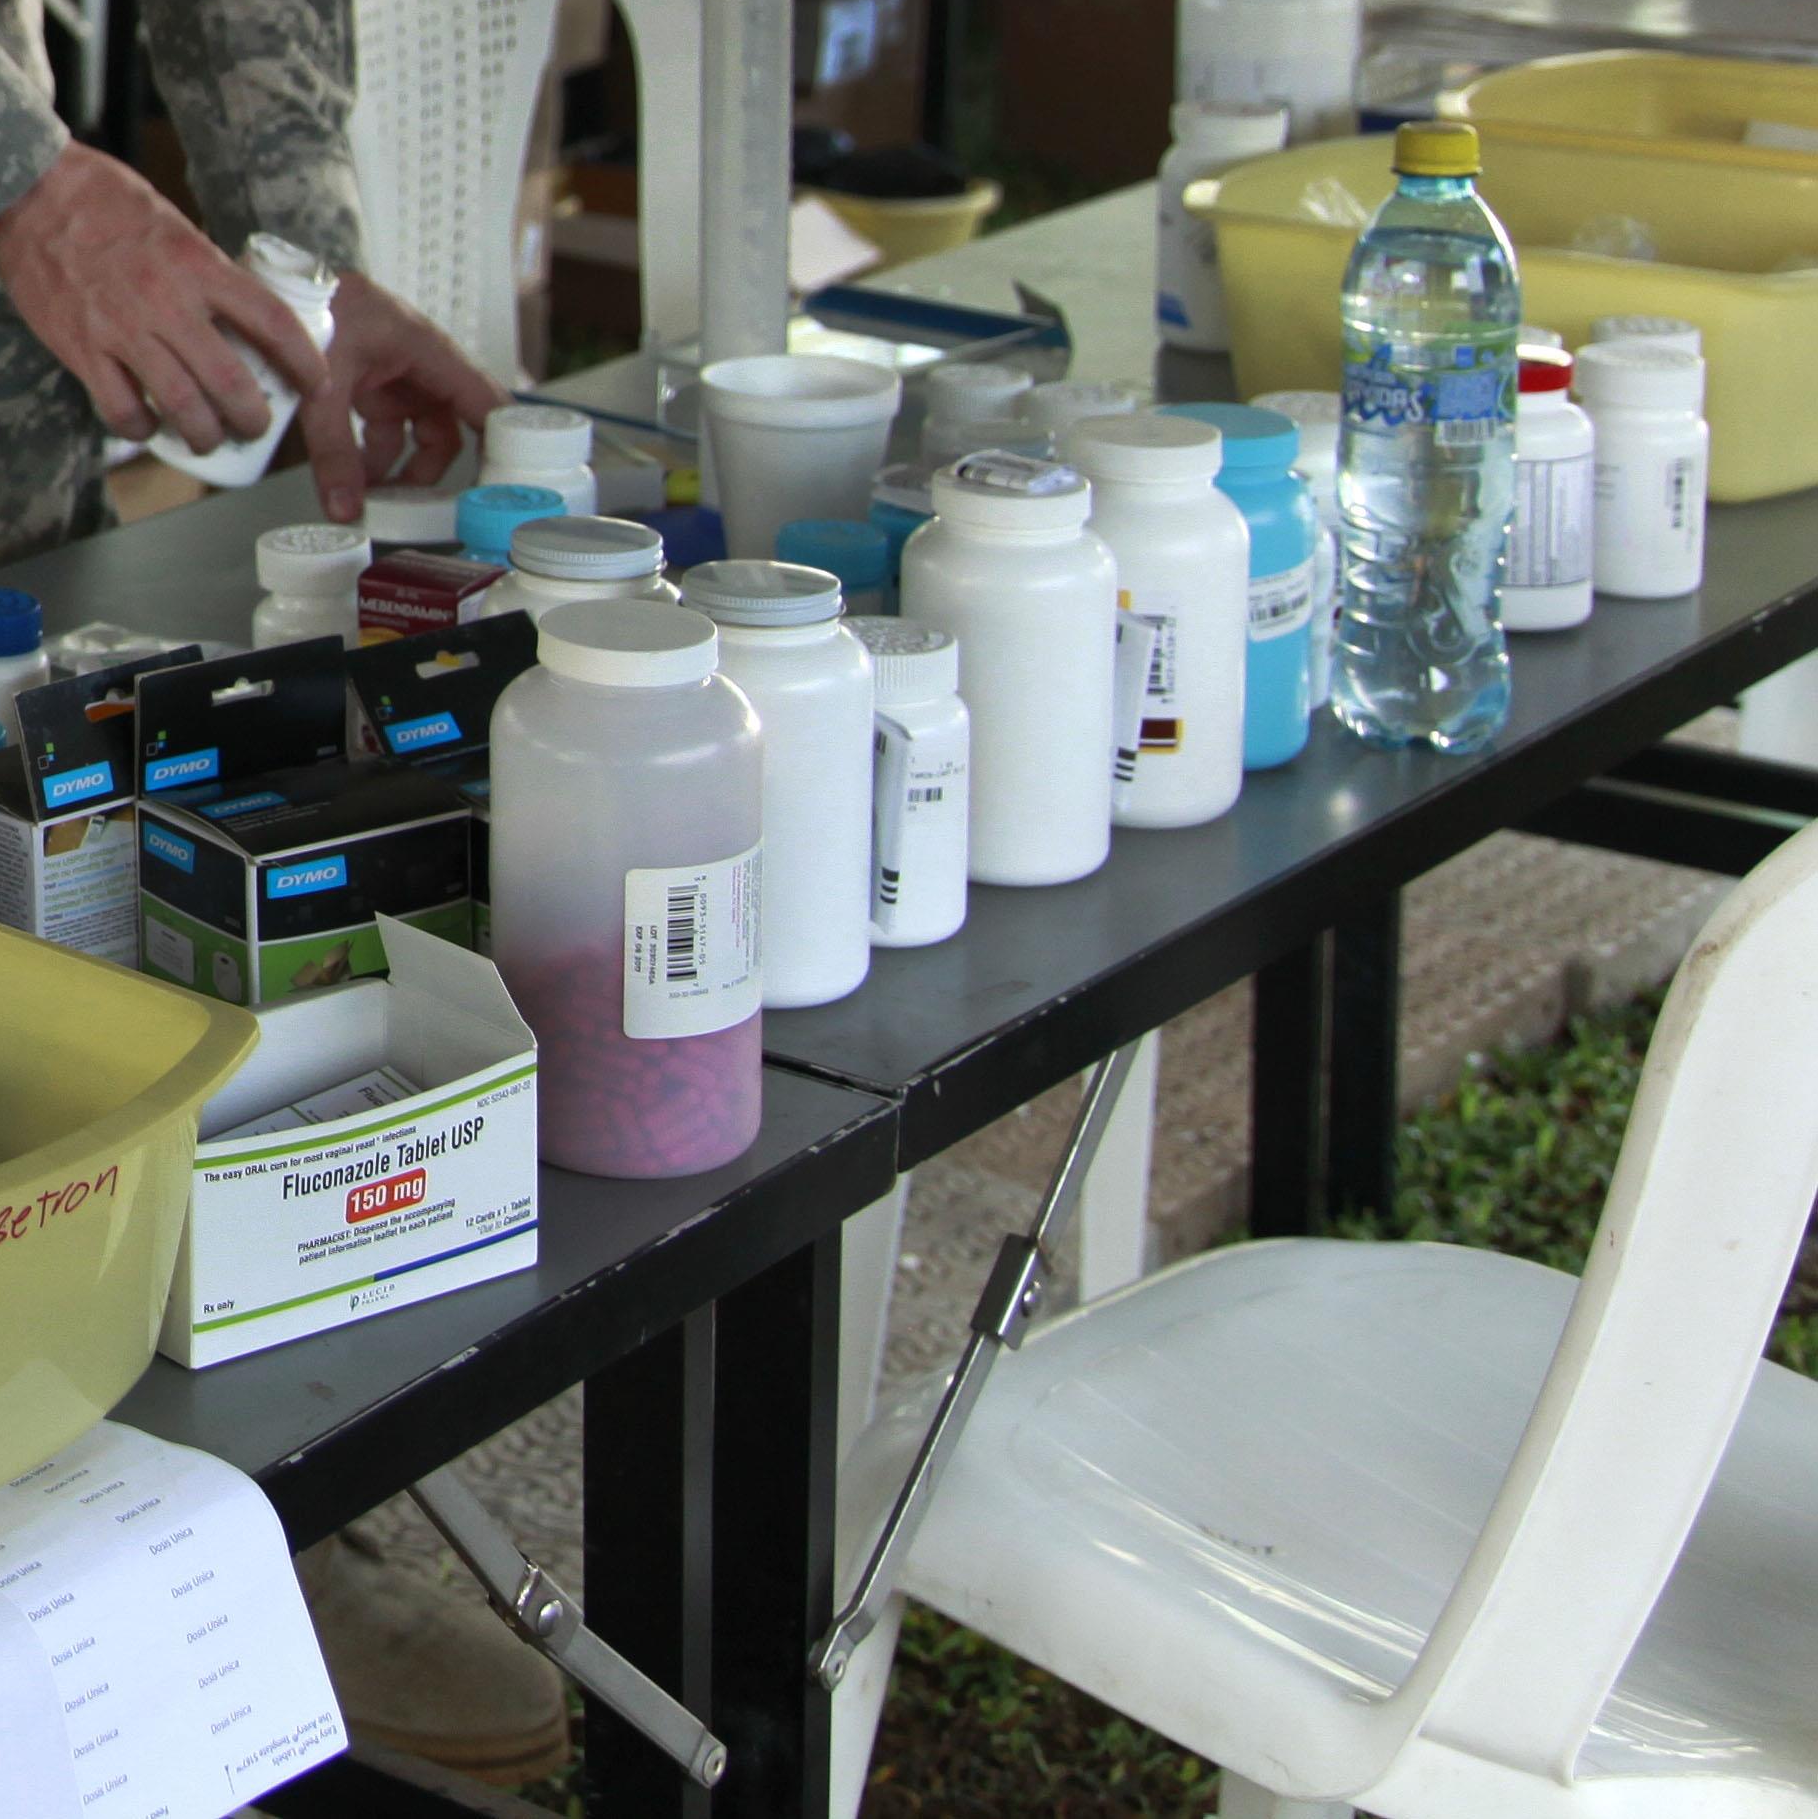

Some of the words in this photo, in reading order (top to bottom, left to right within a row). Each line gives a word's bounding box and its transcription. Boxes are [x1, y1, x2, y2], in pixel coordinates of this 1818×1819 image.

[397, 720, 451, 743] DYMO
[154, 758, 211, 781] DYMO
[52, 773, 105, 799] DYMO
[149, 832, 189, 863] DYMO
[277, 866, 338, 890] DYMO
[204, 1172, 220, 1183] The
[222, 1168, 243, 1181] easy
[245, 1163, 268, 1176] ORAL
[270, 1161, 288, 1171] cure
[290, 1156, 302, 1168] for
[303, 1151, 323, 1164] most
[325, 1143, 354, 1159] vaginal
[381, 1126, 417, 1142] infections
[282, 1153, 390, 1200] Fluconazole
[396, 1133, 446, 1168] Tablet
[451, 1116, 484, 1150] USP
[351, 1185, 387, 1213] 150
[394, 1179, 424, 1202] mg
[297, 1230, 351, 1253] PHARMACIST:
[354, 1219, 388, 1237] Dispense
[390, 1216, 402, 1226] the
[403, 1197, 456, 1223] accompanying
[465, 1218, 474, 1228] 12
[475, 1210, 495, 1225] Cards
[510, 1196, 531, 1215] Tablet
[502, 1208, 531, 1227] Candida
[298, 1248, 327, 1266] patient
[329, 1238, 372, 1257] information
[373, 1229, 397, 1245] leaflet
[399, 1225, 407, 1234] to
[409, 1218, 426, 1232] each
[428, 1209, 453, 1227] patient
[203, 1303, 215, 1314] Rx
[217, 1299, 235, 1312] only
[362, 1283, 396, 1300] LUCID
[115, 1507, 138, 1524] Dosis
[137, 1496, 161, 1516] Unica
[149, 1538, 172, 1557] Dosis
[172, 1526, 194, 1546] Unica
[18, 1560, 42, 1579] Unica
[171, 1580, 193, 1600] Dosis
[192, 1568, 215, 1590] Unica
[28, 1604, 51, 1623] Dosis
[51, 1591, 75, 1613] Unica
[186, 1625, 208, 1645] Dosis
[207, 1613, 229, 1634] Unica
[51, 1647, 73, 1666] Dosis
[73, 1635, 96, 1656] Unica
[198, 1671, 219, 1690] Dosis
[218, 1658, 240, 1679] Unica
[64, 1694, 86, 1713] Dosis
[86, 1681, 110, 1703] Unica
[210, 1715, 231, 1734] Dosis
[231, 1702, 252, 1724] Unica
[317, 1712, 332, 1724] Use
[319, 1724, 337, 1740] Easy
[73, 1740, 95, 1759] Dosis
[95, 1727, 119, 1749] Unica
[259, 1735, 290, 1758] Template
[271, 1747, 296, 1767] Labels
[83, 1785, 105, 1806] Dosis
[104, 1773, 128, 1795] Unica
